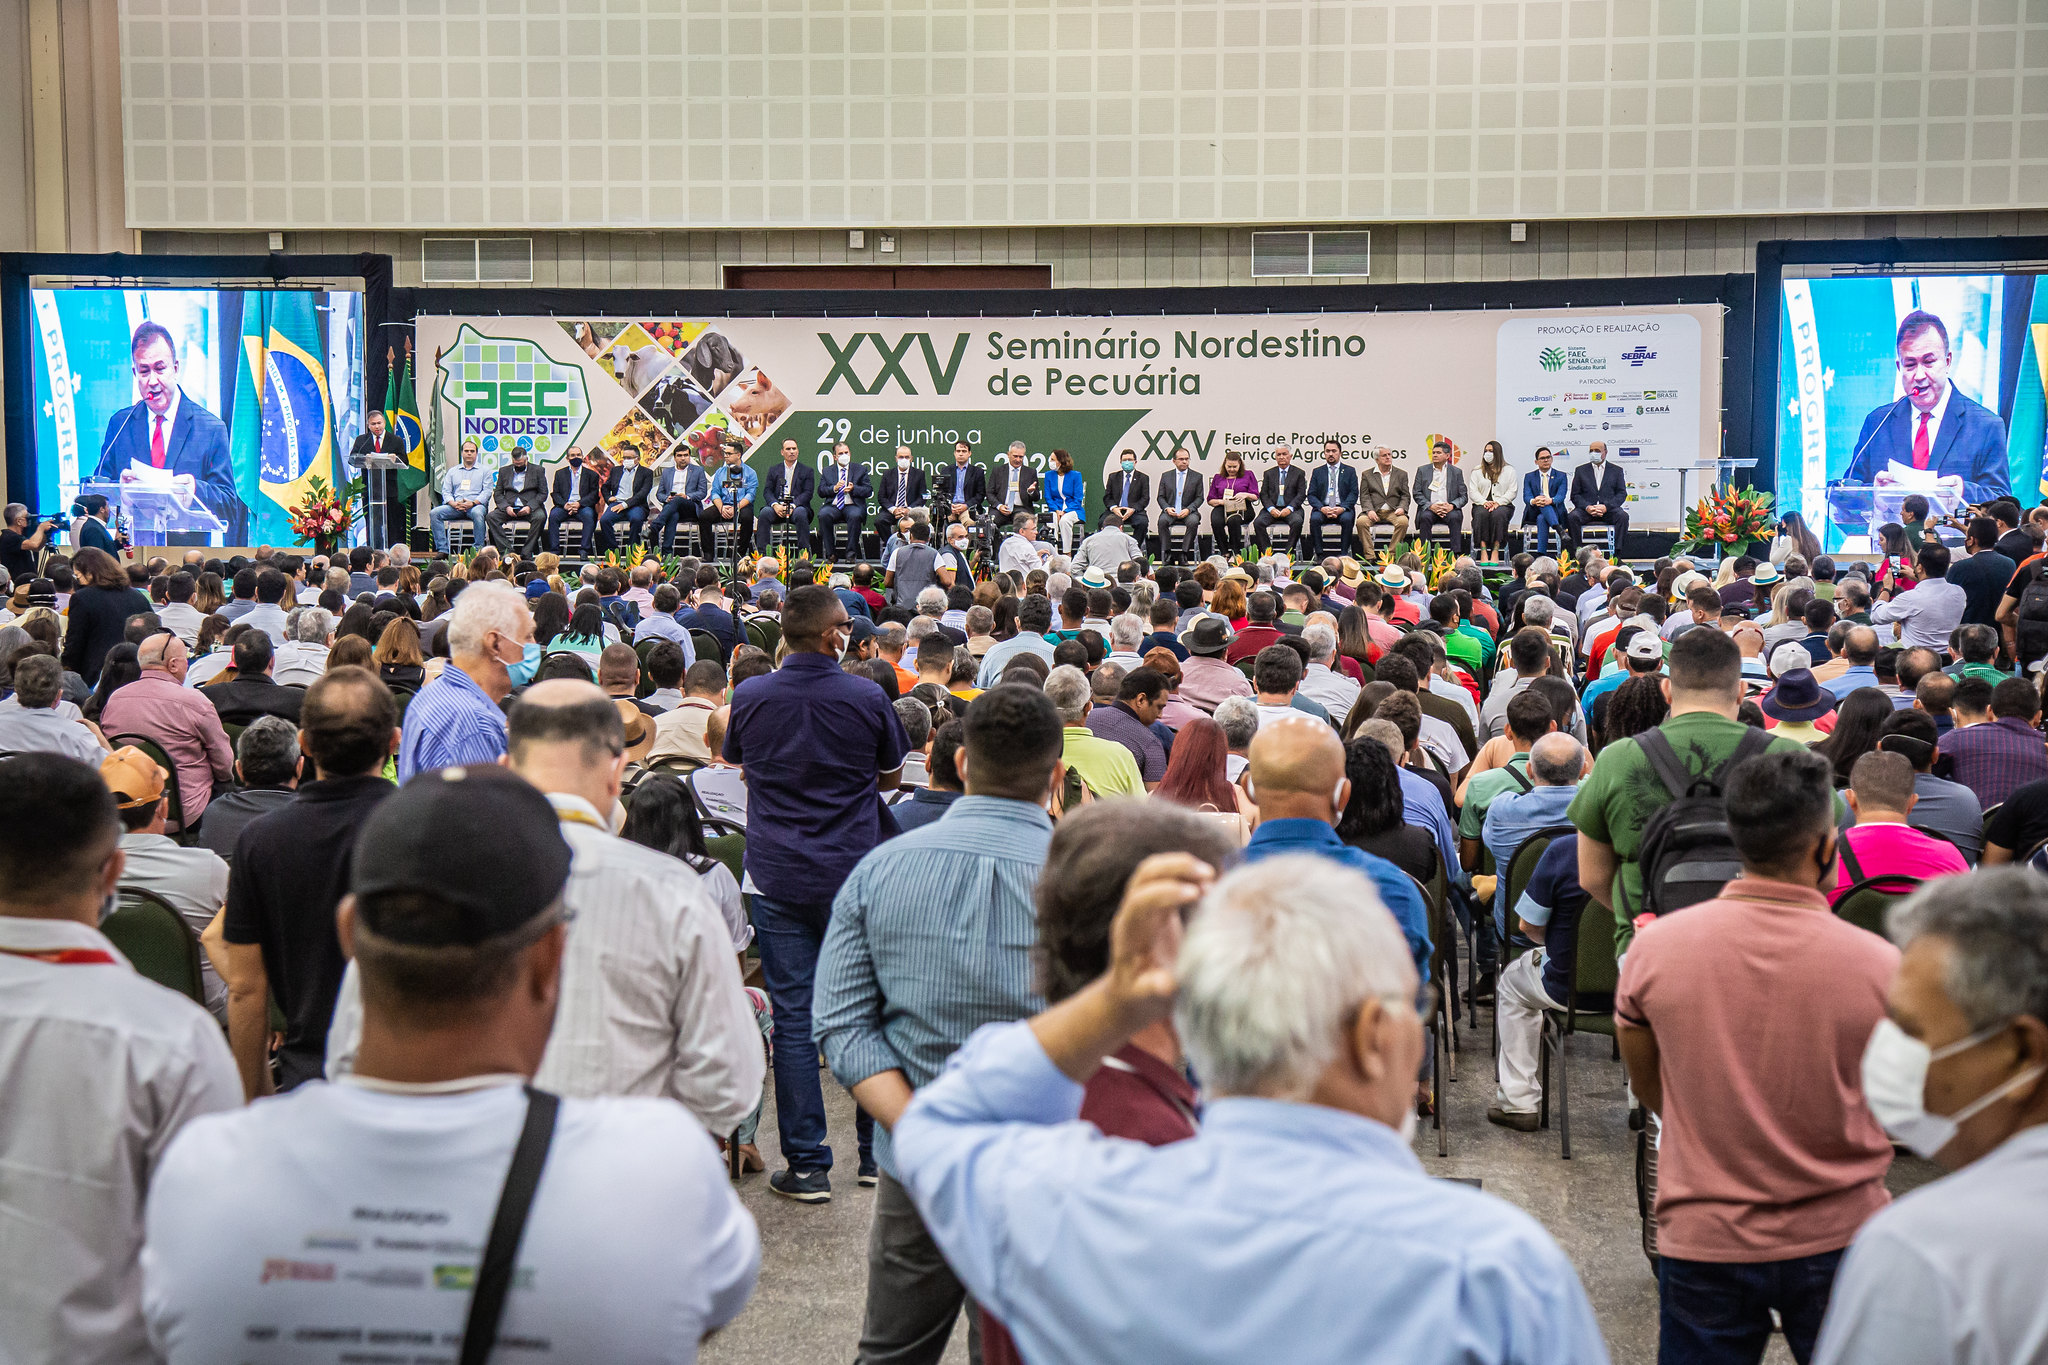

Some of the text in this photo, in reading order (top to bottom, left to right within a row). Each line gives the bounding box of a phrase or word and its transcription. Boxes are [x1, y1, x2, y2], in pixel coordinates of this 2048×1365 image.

[1537, 322, 1660, 335] PROMOÇÃO E REALIZAÇÃO
[987, 328, 1366, 360] Seminário Nordestino
[816, 333, 971, 395] XXV
[1621, 351, 1658, 361] SEBRAE
[987, 364, 1201, 396] de Pecuária
[464, 382, 568, 416] PEC
[1517, 394, 1553, 403] apexBrasil
[1645, 405, 1670, 413] CEARÁ
[464, 417, 569, 435] NORDESTE
[816, 418, 982, 448] 29 de junho a
[1140, 430, 1217, 461] XXV
[1225, 432, 1372, 446] Feira de Produtos e
[860, 457, 890, 476] de
